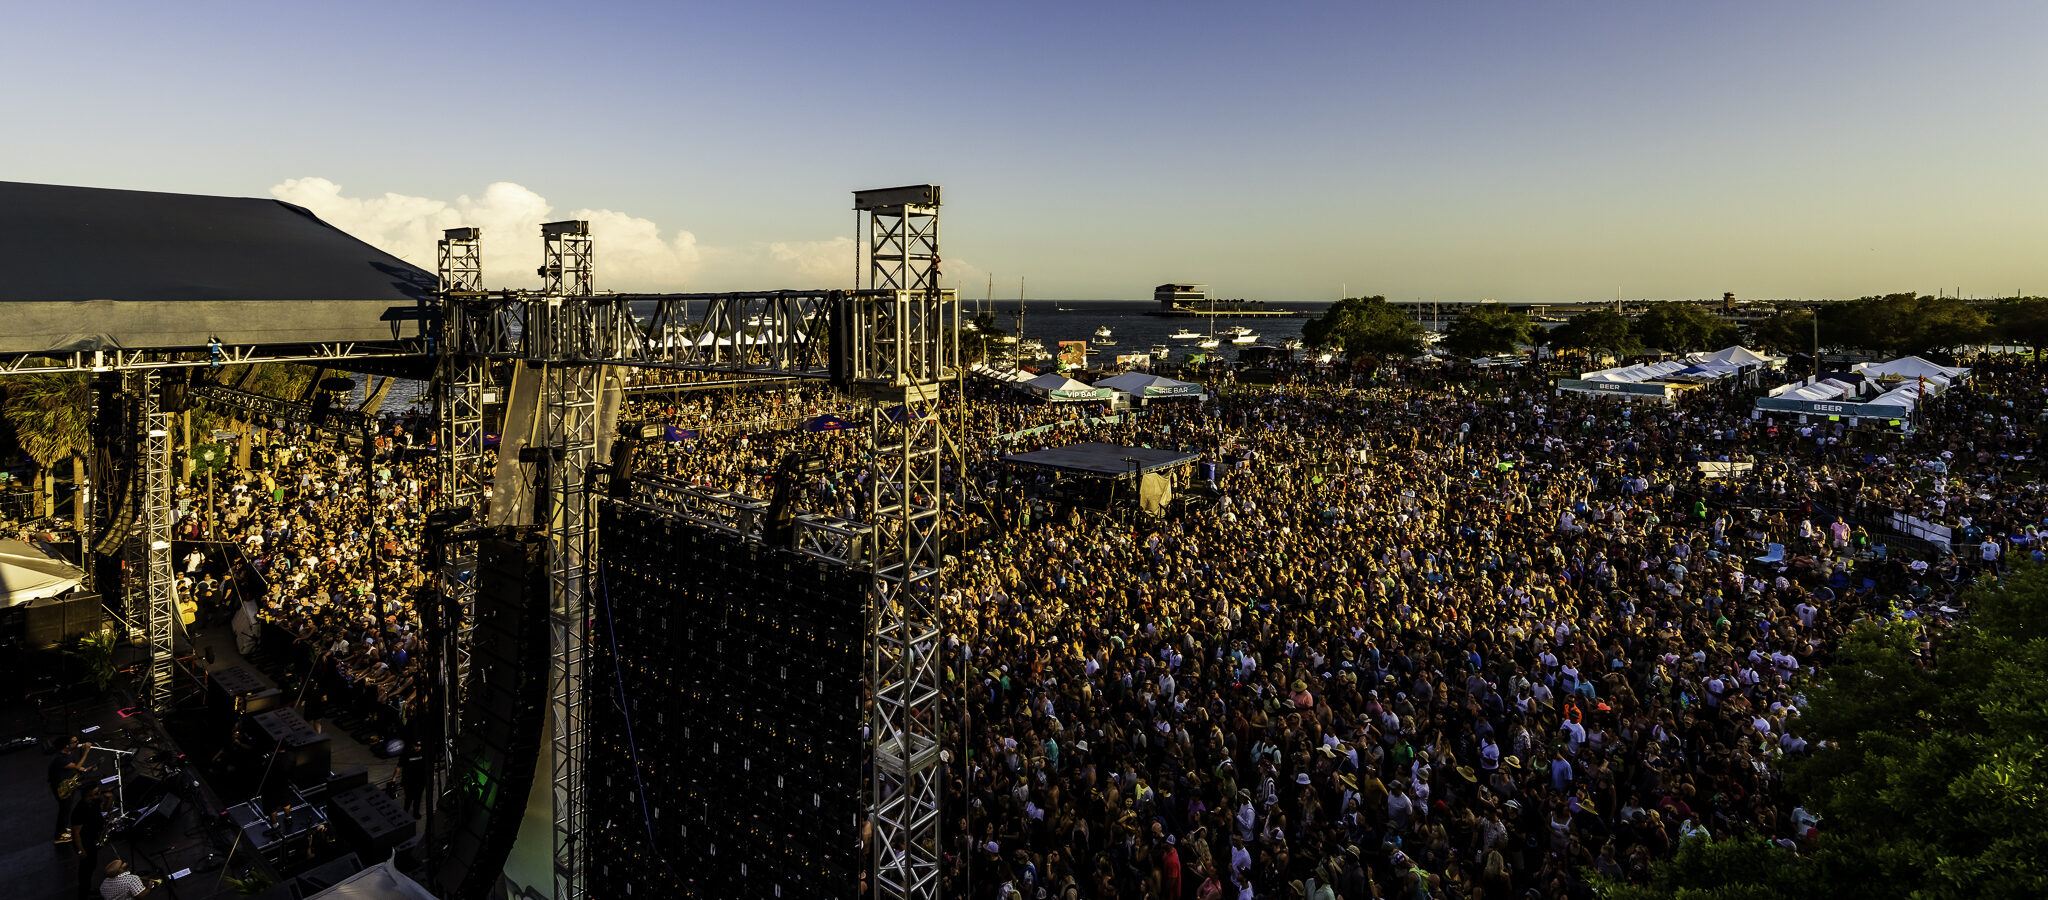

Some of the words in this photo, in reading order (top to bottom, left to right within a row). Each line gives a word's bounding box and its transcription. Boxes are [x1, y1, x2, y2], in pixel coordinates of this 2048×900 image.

[1080, 390, 1097, 398] BAR
[1173, 386, 1188, 394] BAR
[1813, 403, 1843, 412] BEER
